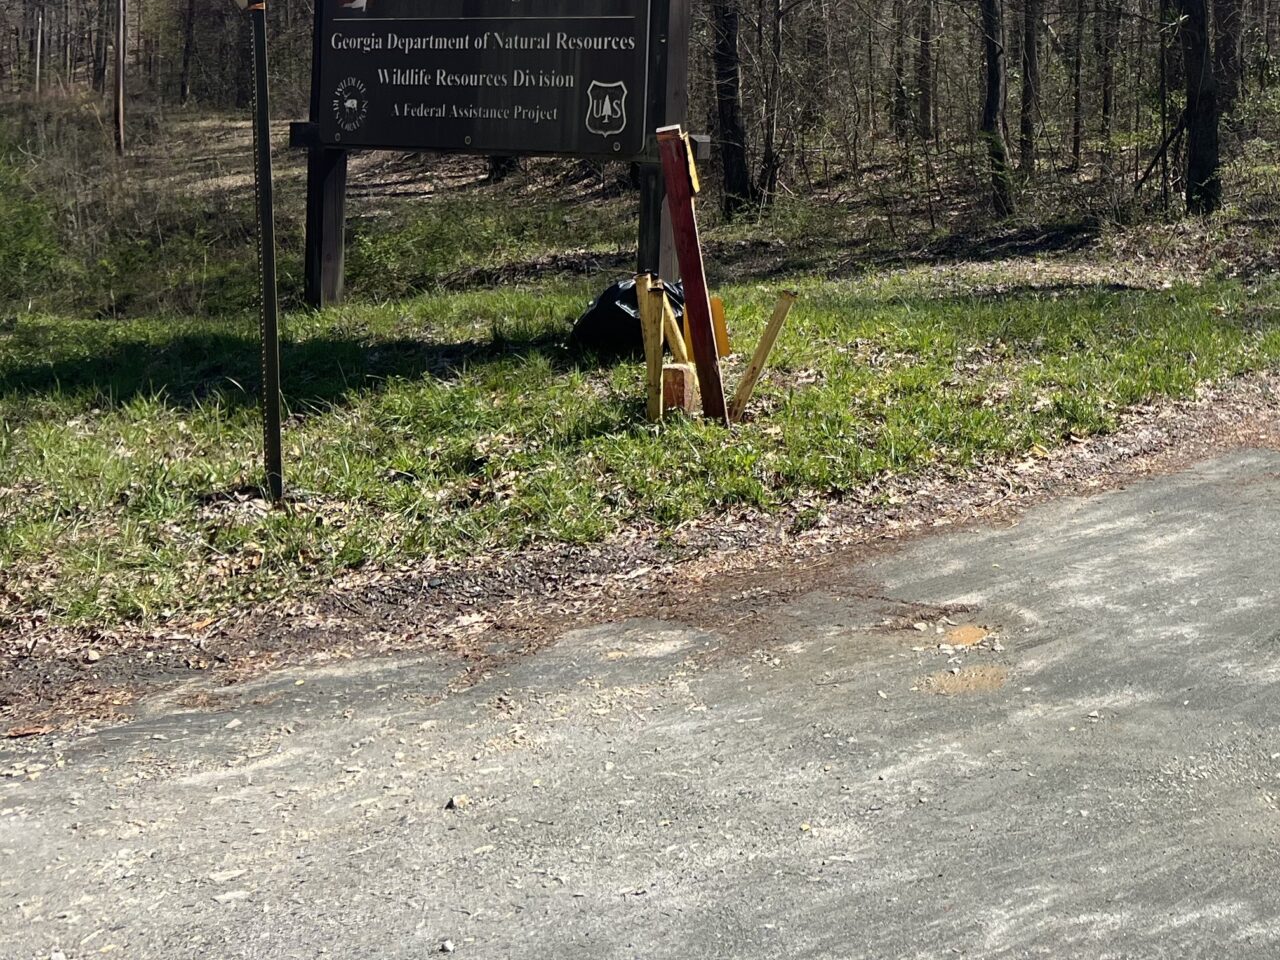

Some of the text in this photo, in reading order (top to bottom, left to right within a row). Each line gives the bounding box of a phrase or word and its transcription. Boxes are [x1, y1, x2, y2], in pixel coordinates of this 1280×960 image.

[331, 32, 636, 54] Georgia Department of Natural Resources
[377, 68, 574, 88] Wildlife Resources Division
[392, 103, 558, 124] A Federal Assistance Project
